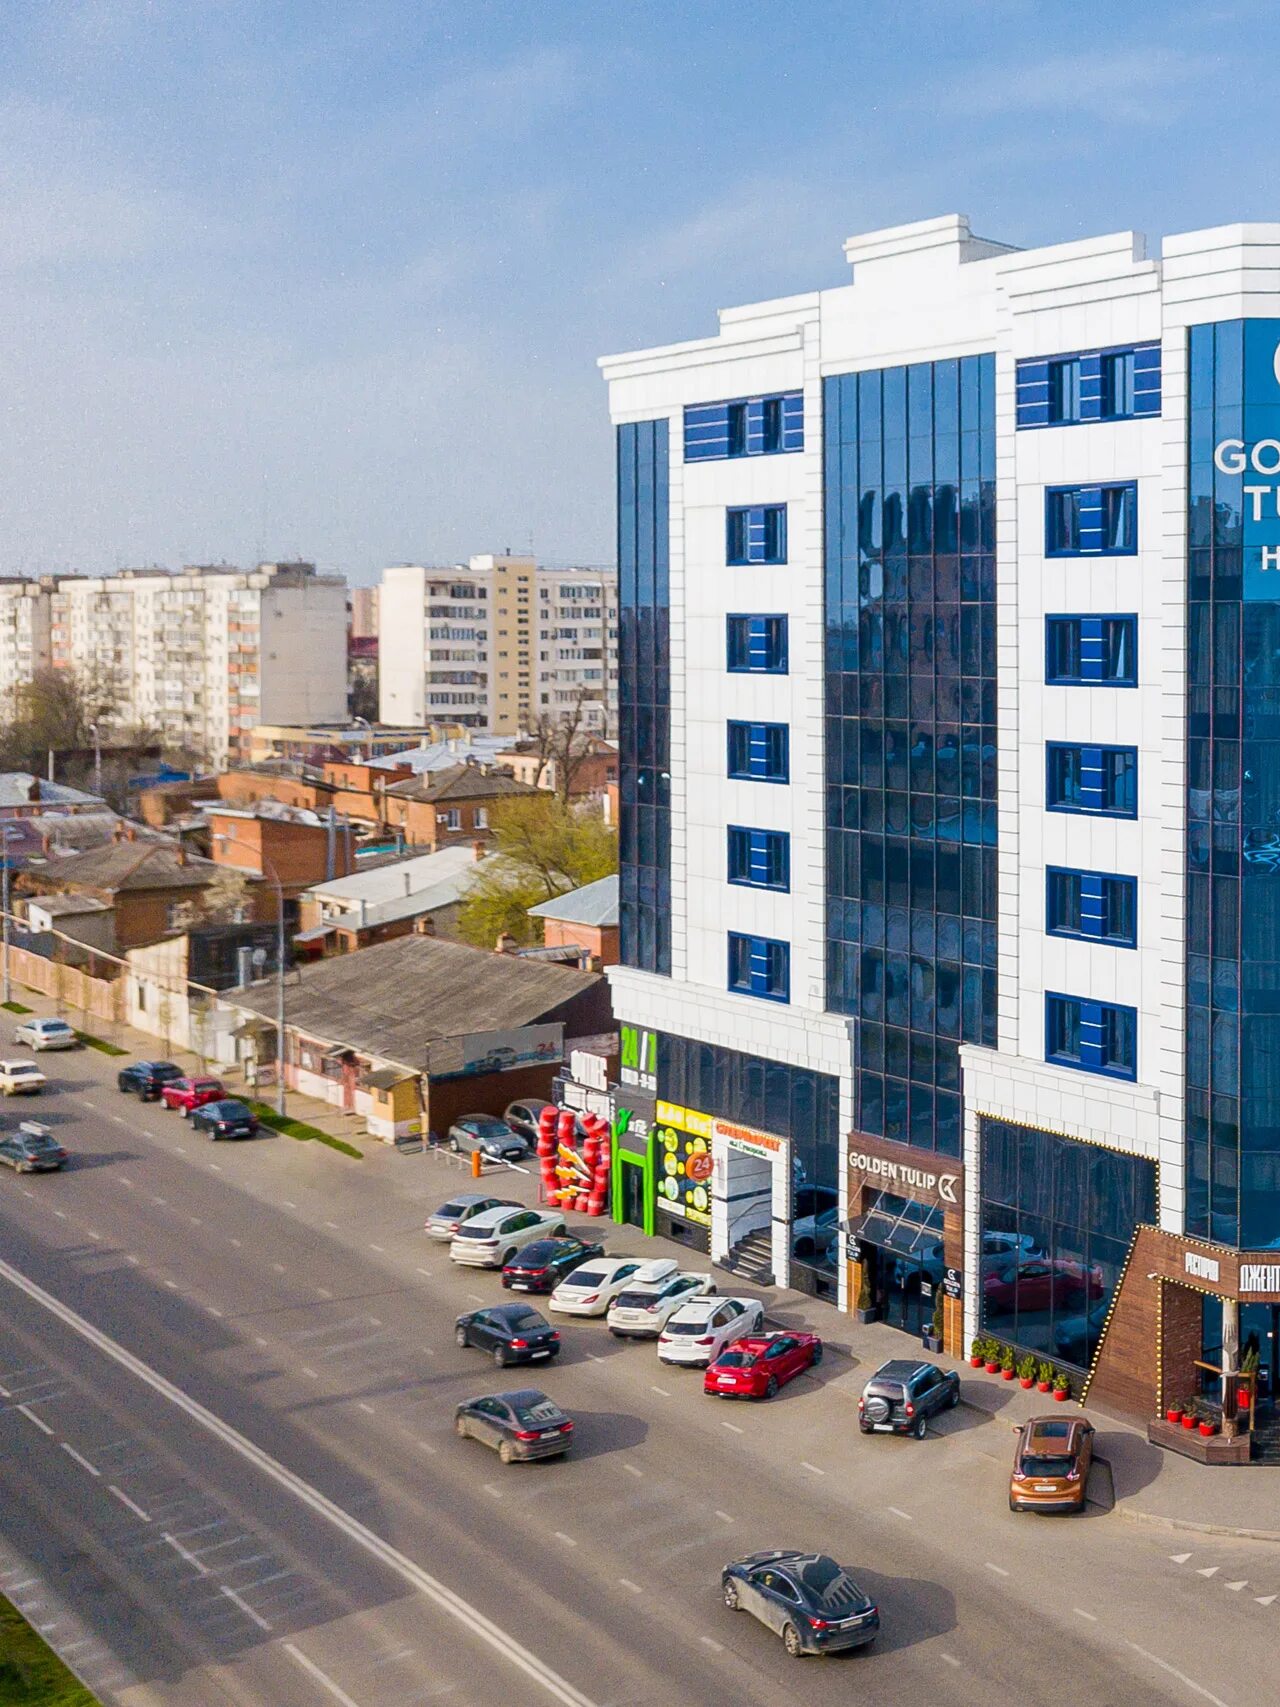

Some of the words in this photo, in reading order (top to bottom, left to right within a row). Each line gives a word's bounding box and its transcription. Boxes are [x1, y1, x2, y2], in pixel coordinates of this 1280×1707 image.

[621, 1026, 656, 1073] 24/7
[694, 1156, 710, 1172] 24
[848, 1152, 897, 1180] GOLDEN
[899, 1166, 936, 1190] TULIP
